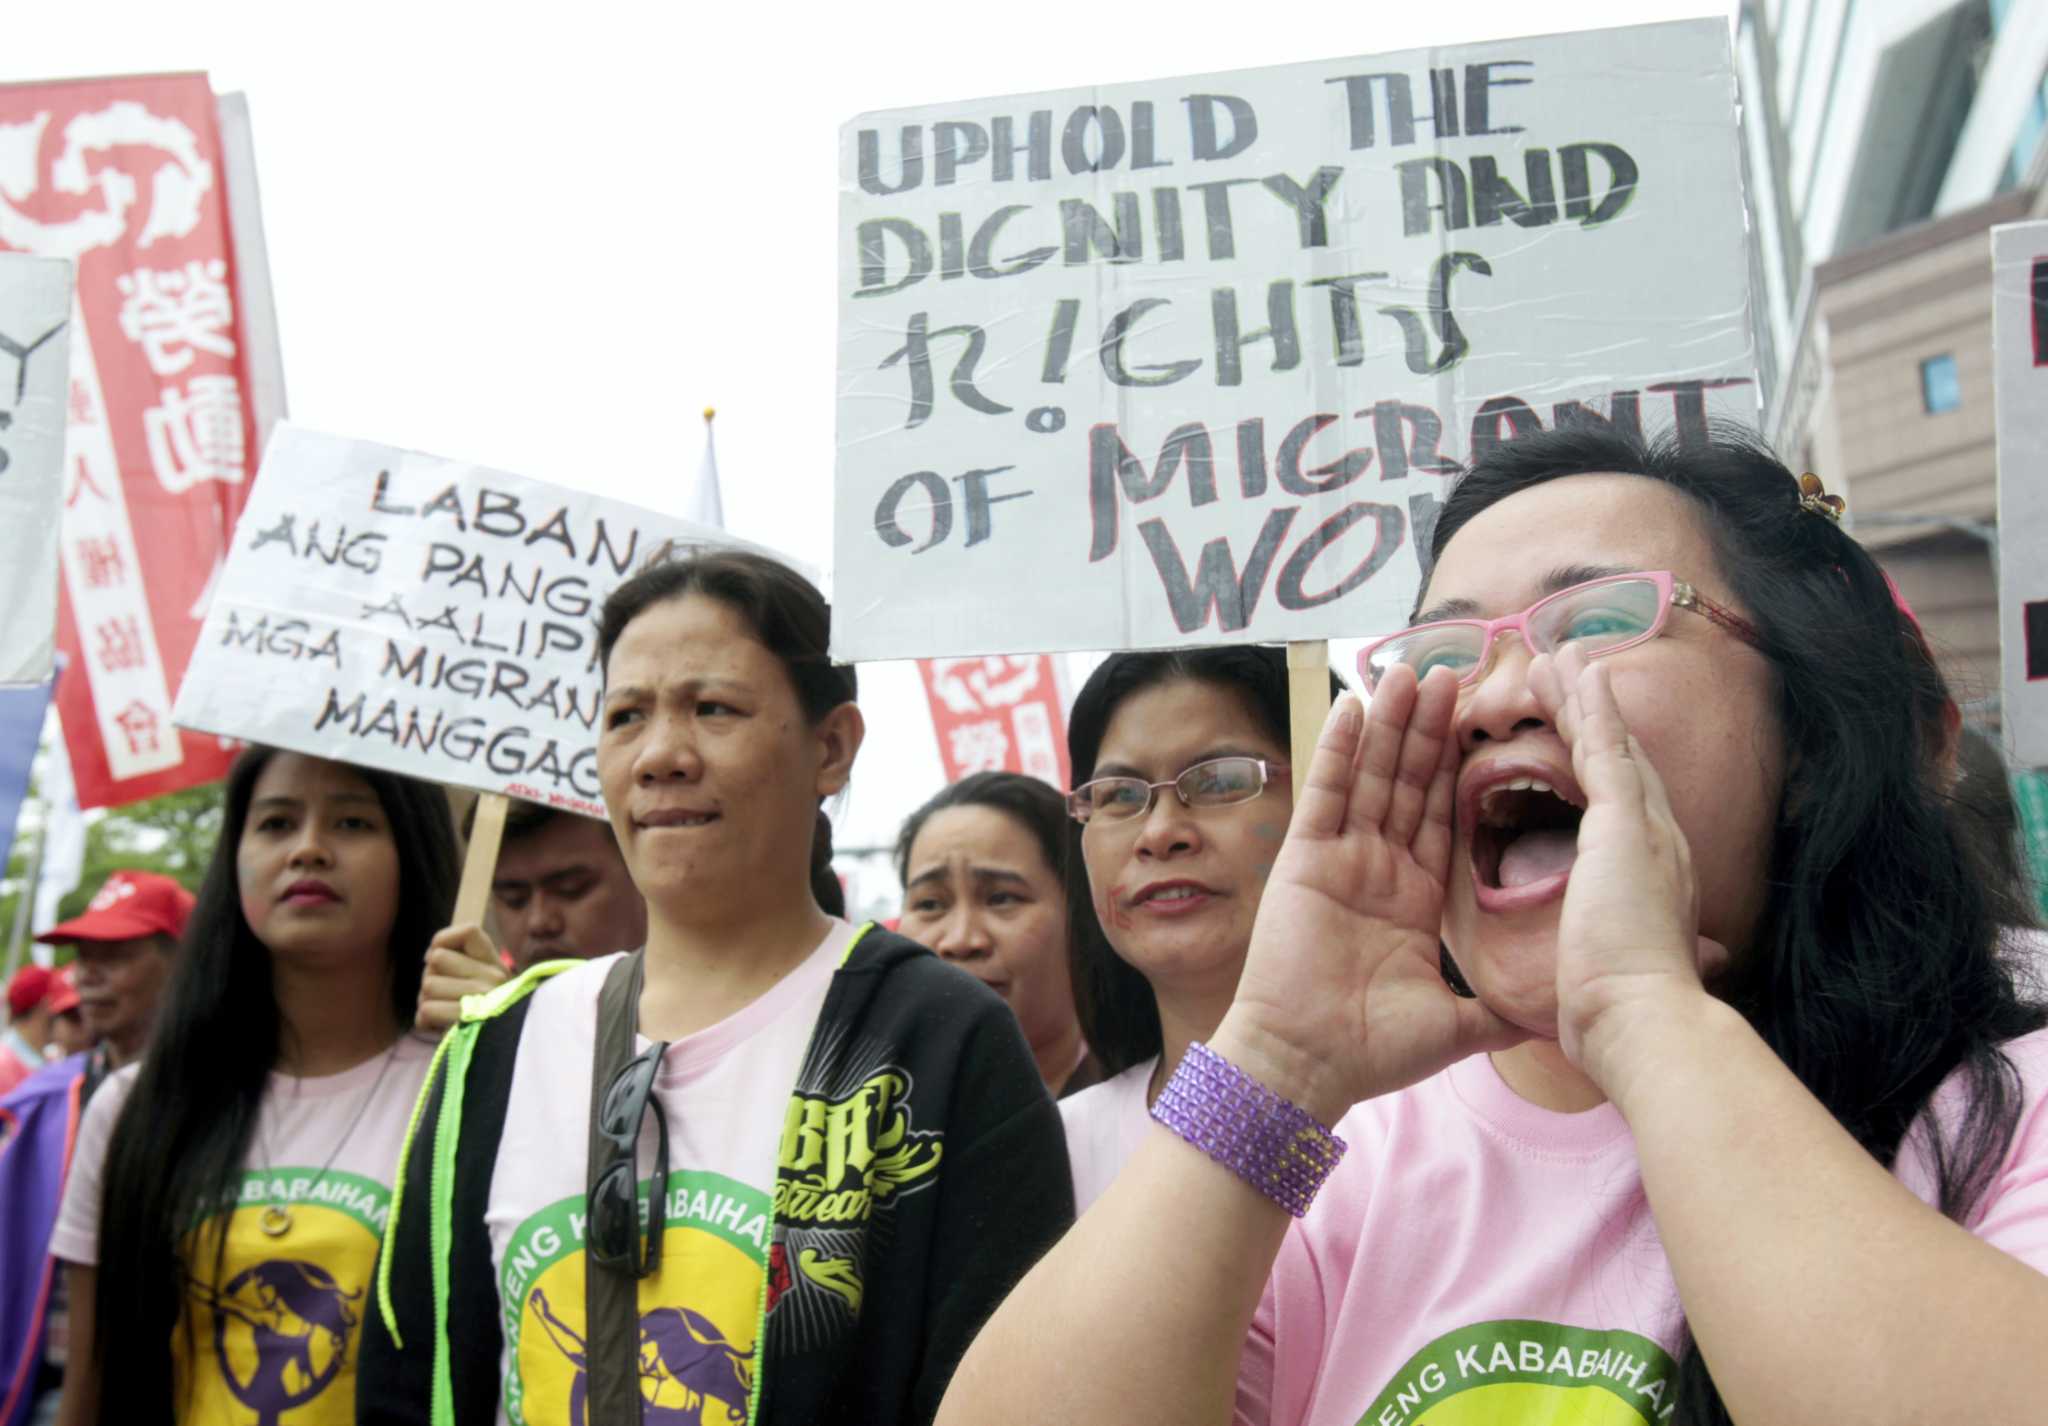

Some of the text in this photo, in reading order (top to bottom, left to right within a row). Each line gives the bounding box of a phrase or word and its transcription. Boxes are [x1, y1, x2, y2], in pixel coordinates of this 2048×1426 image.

[856, 60, 1534, 197] UPHOLD THE
[850, 141, 1638, 299] DIGNITY AND
[369, 469, 674, 576] LABAN
[872, 377, 1754, 562] OF MIGRANT
[249, 512, 387, 572] ANG
[220, 610, 602, 731] MGA MIGRAN
[361, 590, 601, 674] AALIPI
[315, 687, 602, 799] MANGGAG
[774, 1174, 872, 1223] etwear
[1367, 1362, 1447, 1426] ENG
